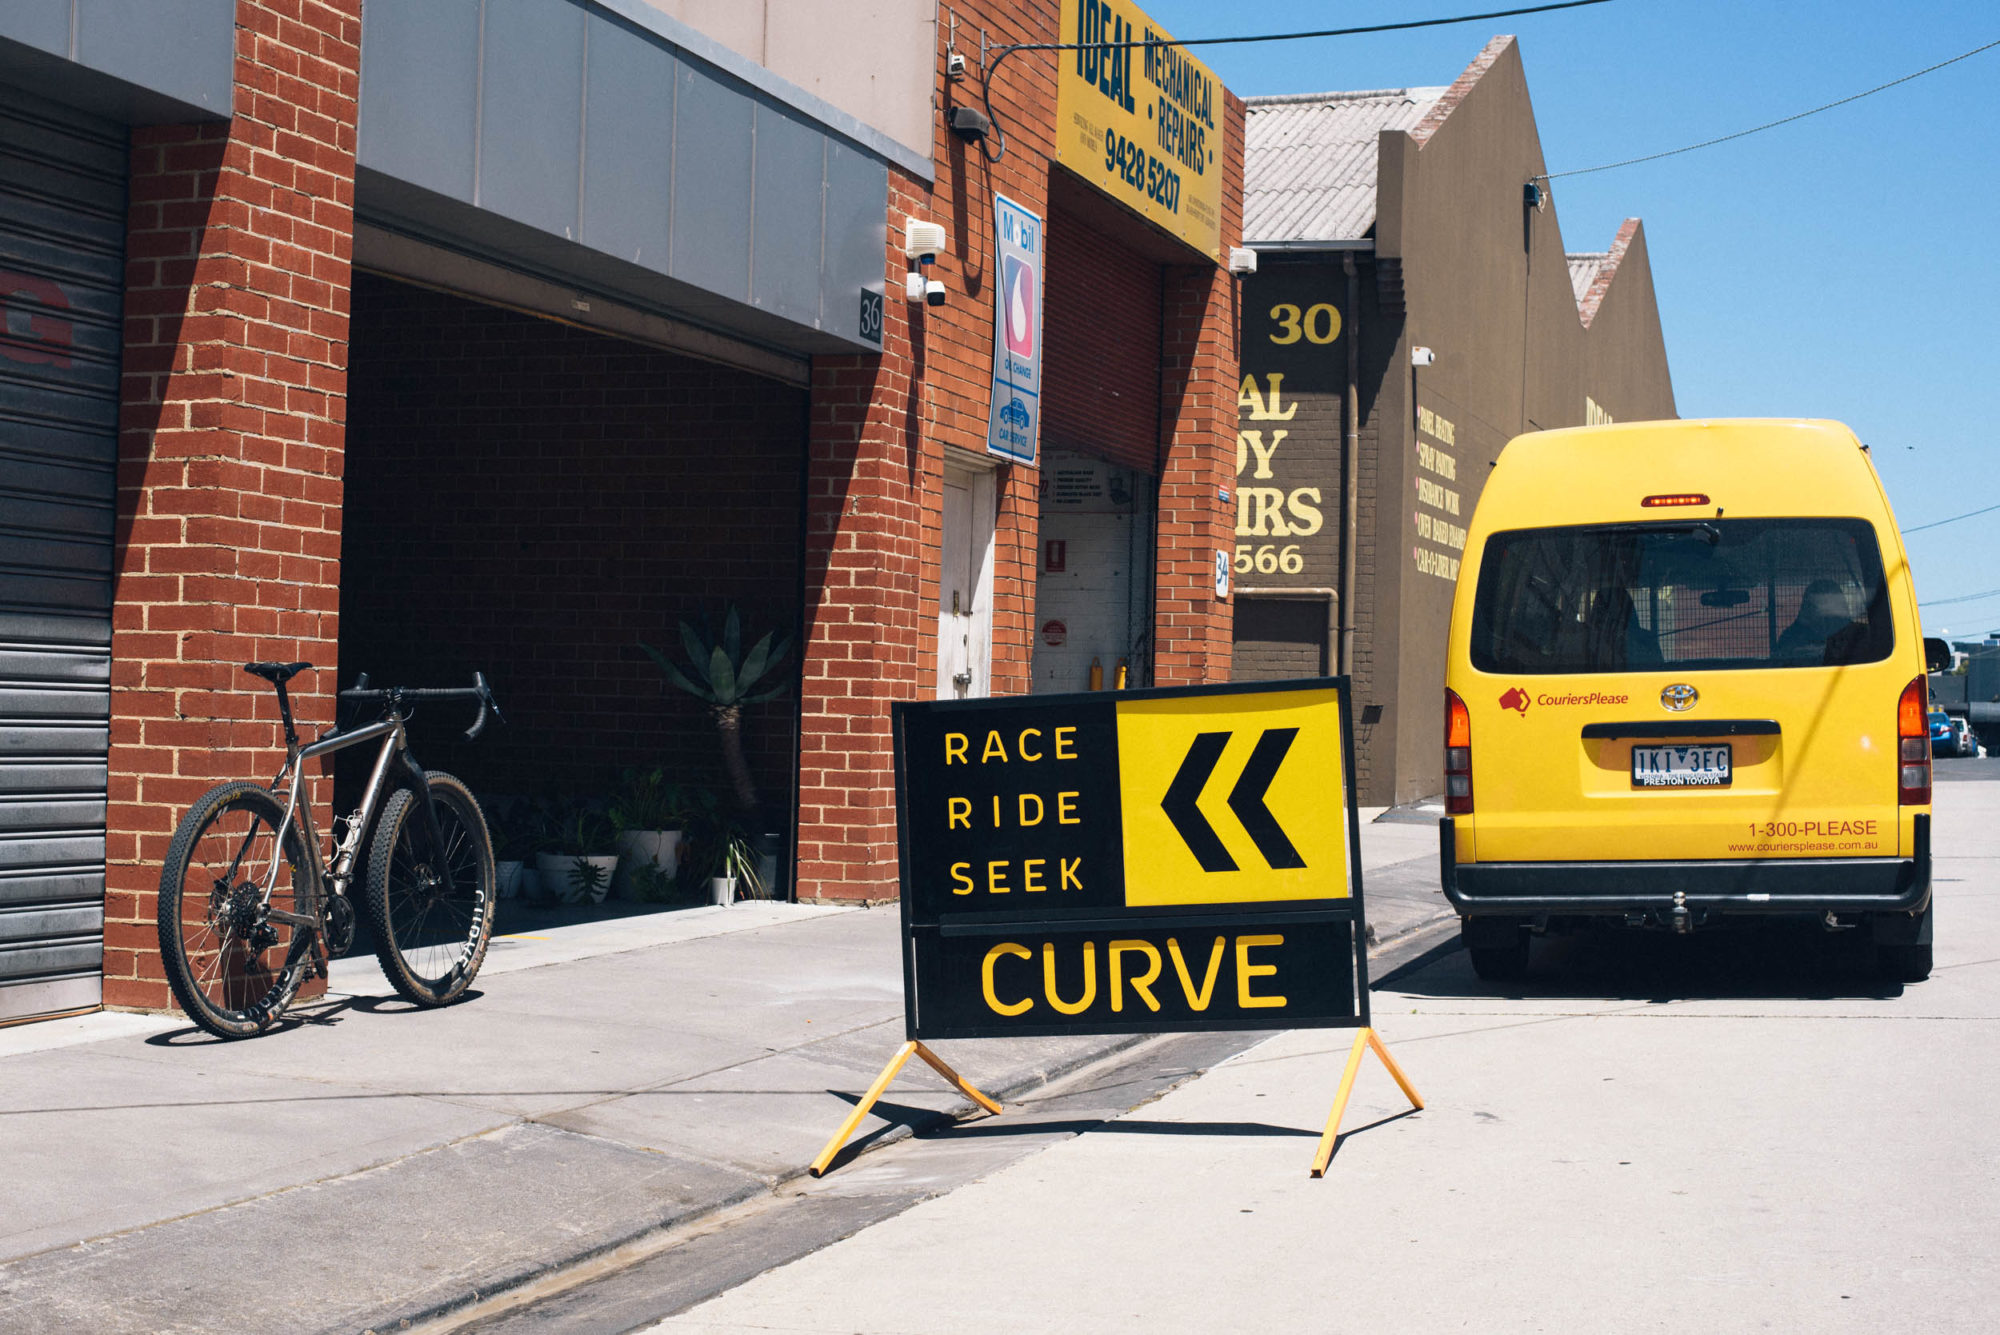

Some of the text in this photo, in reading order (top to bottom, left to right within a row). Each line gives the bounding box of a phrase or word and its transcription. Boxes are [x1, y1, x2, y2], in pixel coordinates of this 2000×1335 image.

[1077, 0, 1135, 115] IDEAL
[1144, 26, 1214, 131] MECHANICAL
[1158, 95, 1205, 176] REPAIRS
[1105, 127, 1146, 192] 9428
[1147, 155, 1181, 215] 5207
[1003, 210, 1035, 254] Mobil
[861, 296, 880, 334] 36
[1269, 303, 1342, 345] 30
[1013, 361, 1032, 380] CHANGE
[999, 427, 1028, 447] CAR SERVICE
[1216, 550, 1229, 588] 34
[1537, 692, 1629, 707] CouriersPlease
[944, 726, 1079, 766] RACE
[1639, 749, 1727, 774] 1KI 3EC
[1643, 777, 1721, 786] PRESTON TOYOTA
[948, 791, 1081, 830] RIDE
[1748, 820, 1878, 837] 1-300-PLEASE
[1728, 841, 1878, 853] www.couriersplease.com.au
[950, 857, 1083, 896] SEEK
[981, 934, 1287, 1017] CURVE
